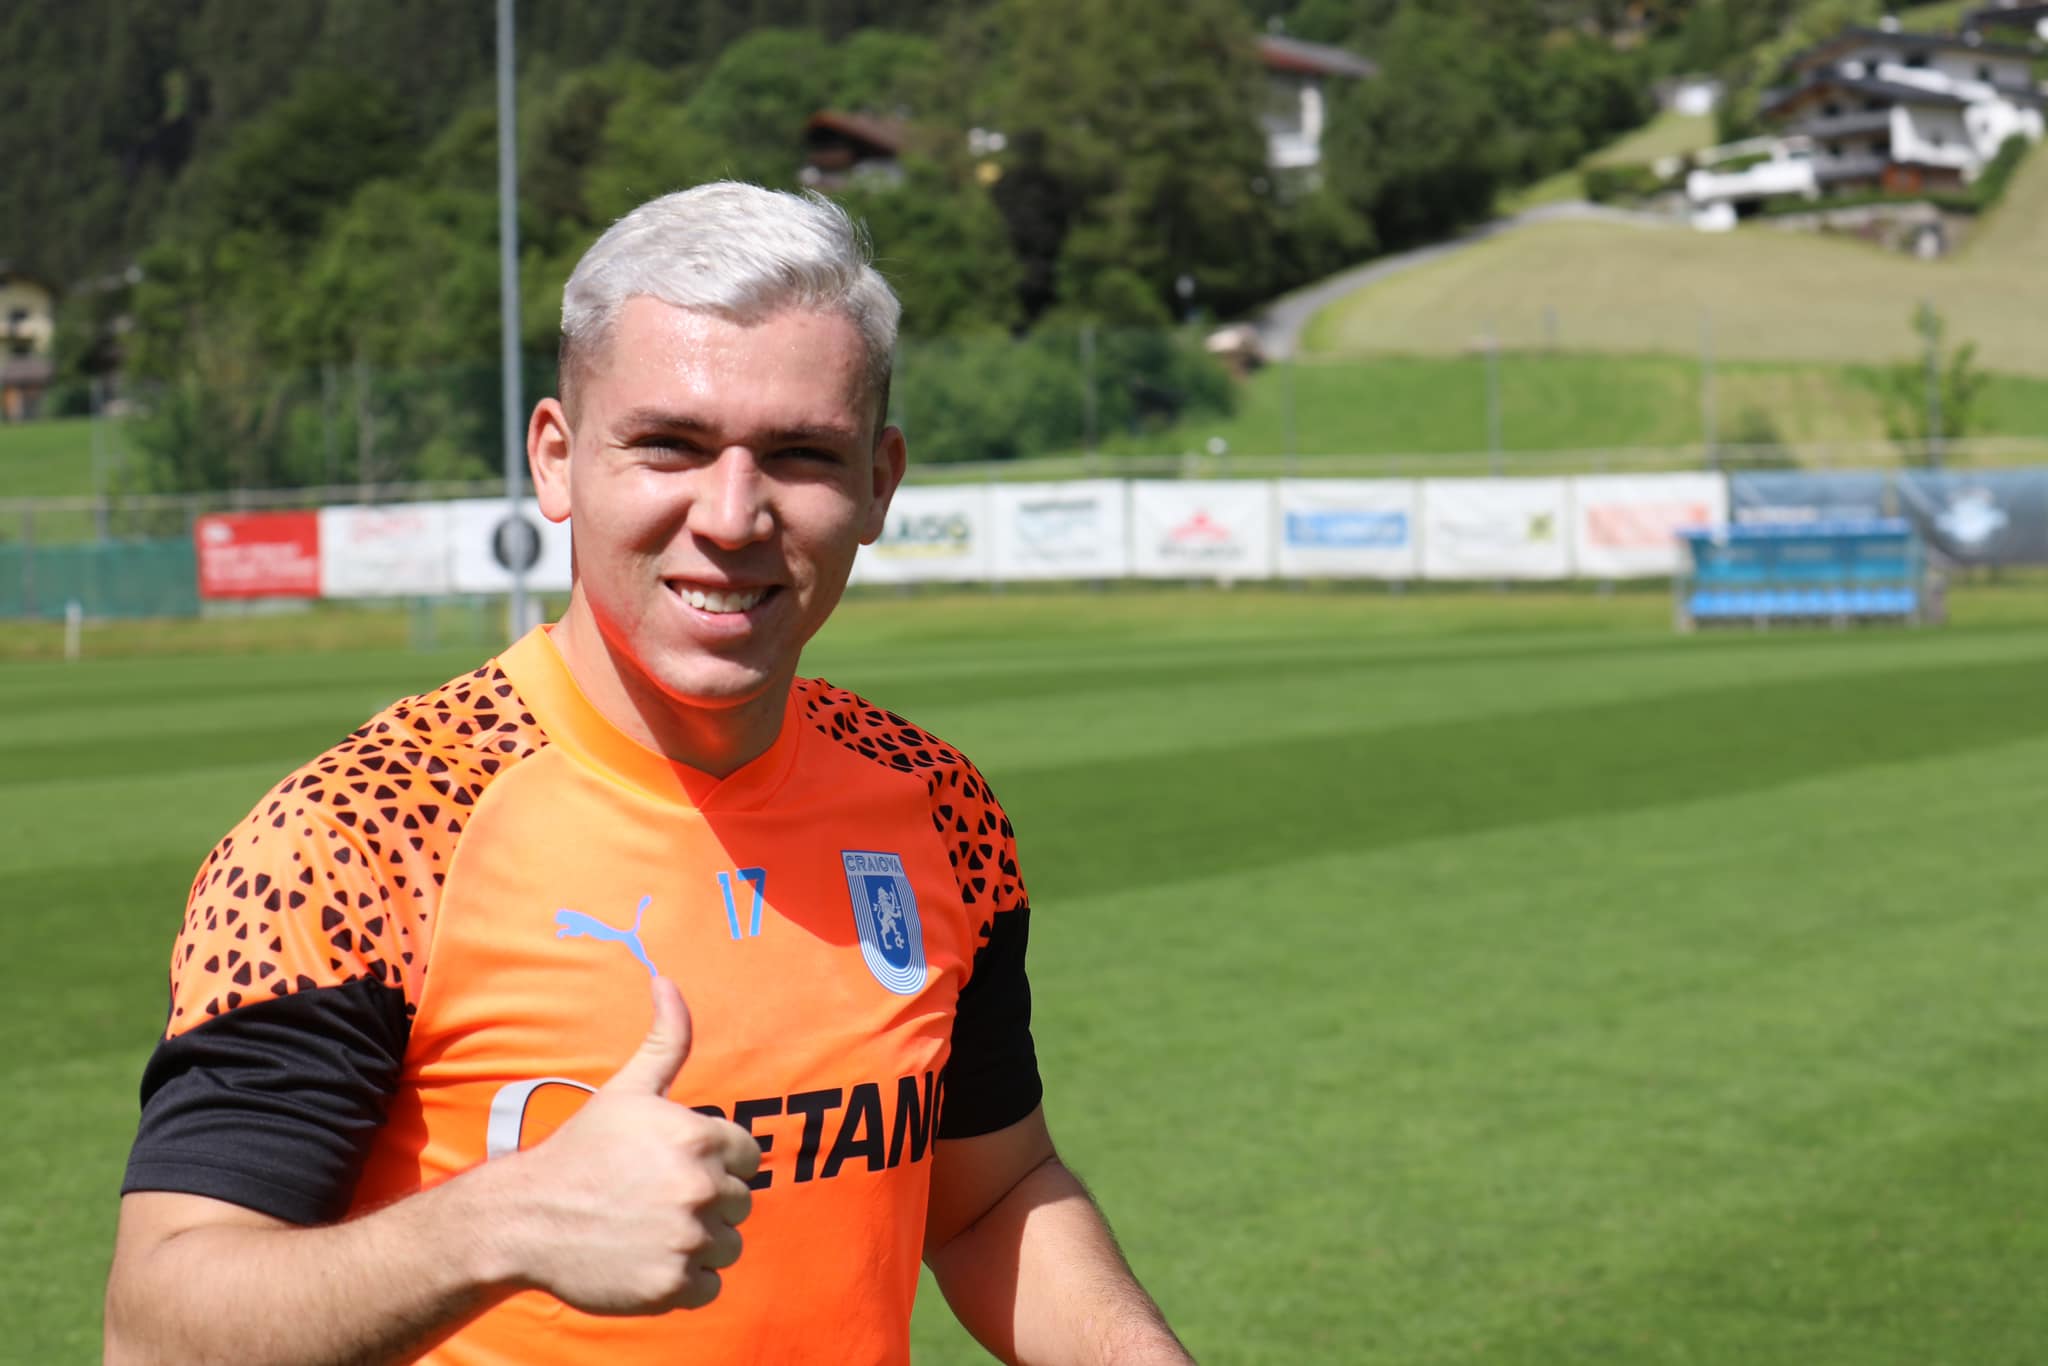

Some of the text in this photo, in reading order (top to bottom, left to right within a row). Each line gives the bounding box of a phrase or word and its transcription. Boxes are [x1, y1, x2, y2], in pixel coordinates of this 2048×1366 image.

[845, 855, 903, 872] CRAIOVA
[716, 866, 767, 940] 17
[690, 1068, 945, 1191] ETAN
